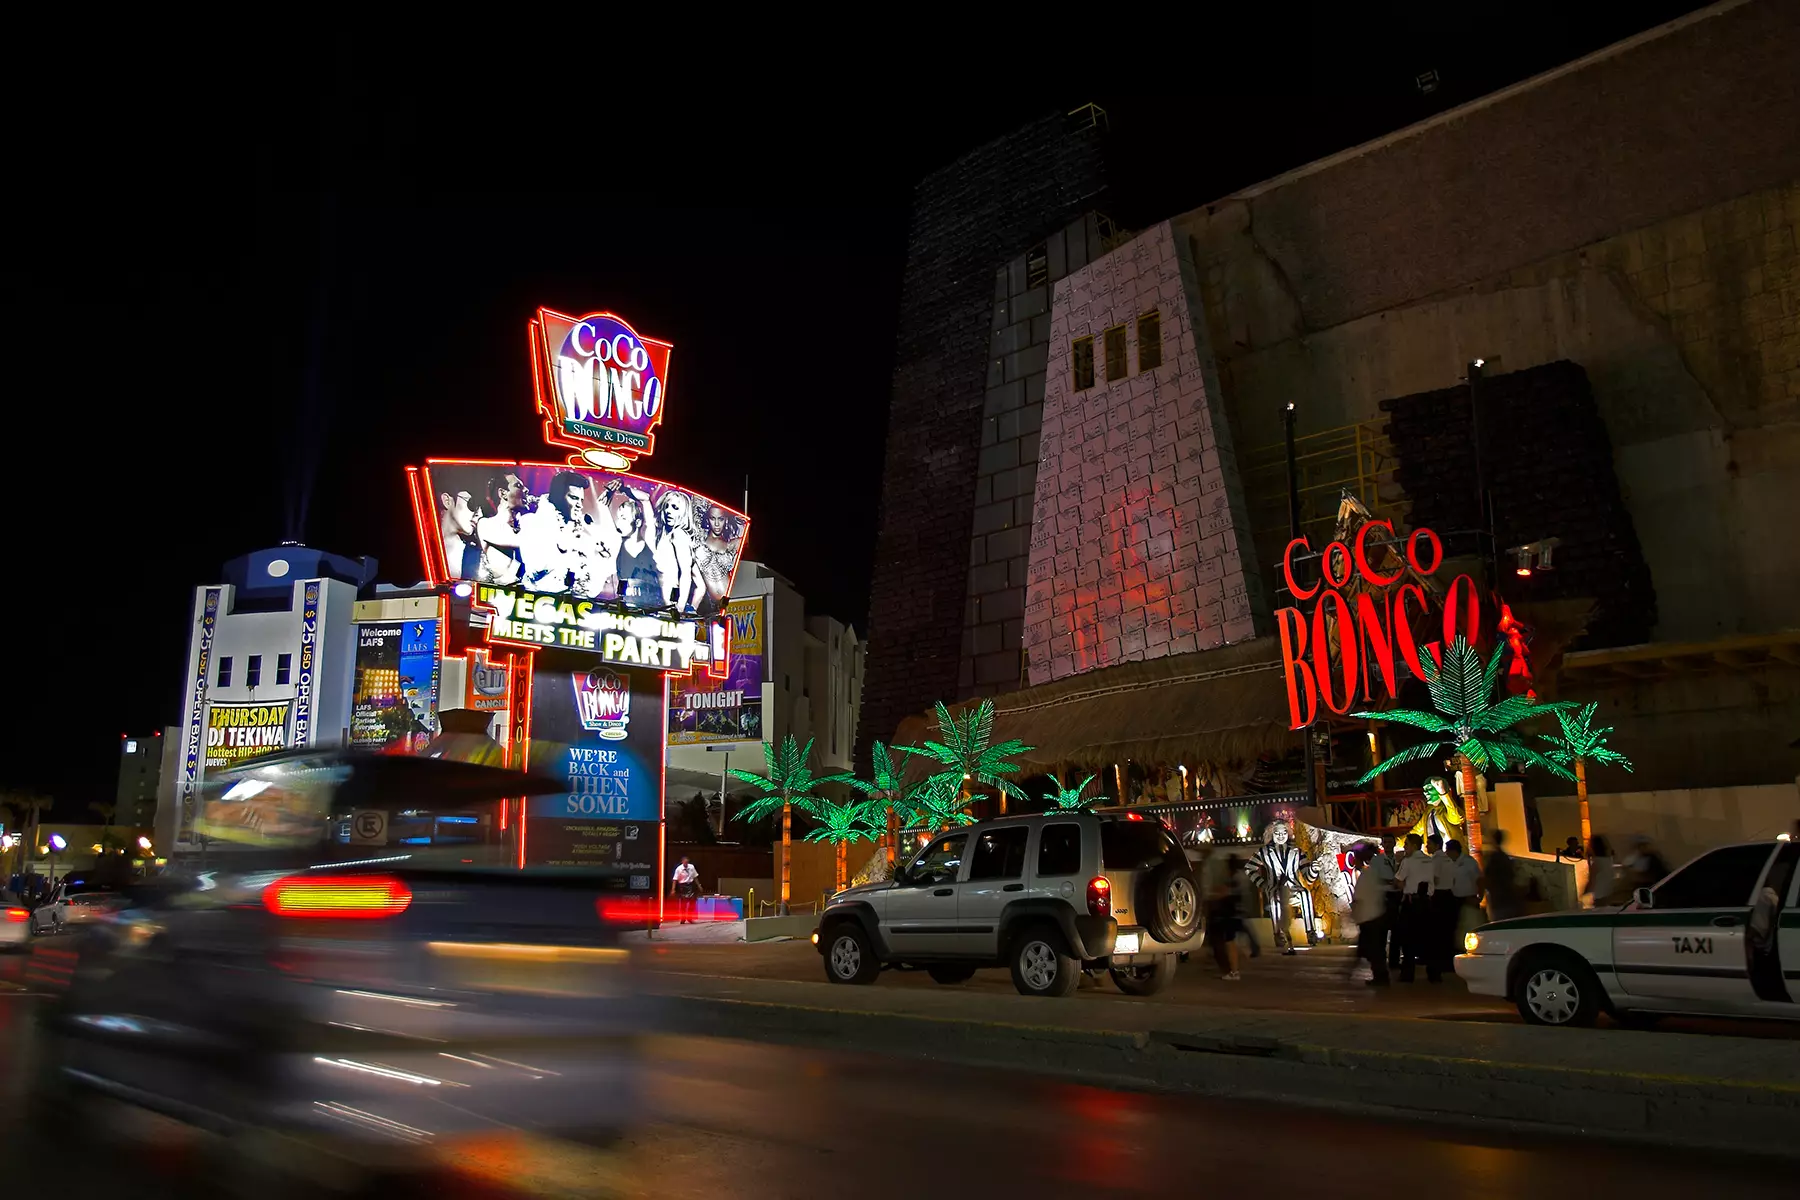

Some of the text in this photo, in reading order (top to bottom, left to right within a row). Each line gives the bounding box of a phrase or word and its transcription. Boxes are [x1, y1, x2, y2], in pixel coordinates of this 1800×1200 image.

[557, 356, 662, 421] BONGO
[573, 423, 644, 447] Show & Disco
[304, 610, 315, 618] $
[200, 627, 213, 649] 25
[302, 621, 316, 645] 25
[360, 638, 384, 647] LAFS
[361, 627, 402, 637] Welcome
[493, 619, 595, 648] MEETS THE
[301, 645, 312, 670] USD
[1273, 574, 1481, 731] BONGO
[297, 673, 311, 716] OPEN
[581, 687, 629, 721] BONGO
[684, 690, 744, 709] TONIGHT
[211, 707, 288, 727] THURSDAY
[188, 724, 200, 755] BAR
[207, 725, 285, 746] DJ TEKIWA
[205, 757, 228, 767] JUEVES
[207, 747, 237, 758] Hottest
[569, 747, 618, 763] WE'RE
[568, 761, 630, 777] BACK and
[568, 775, 629, 796] THEN
[566, 794, 630, 815] SOME
[1671, 936, 1714, 954] TAXI
